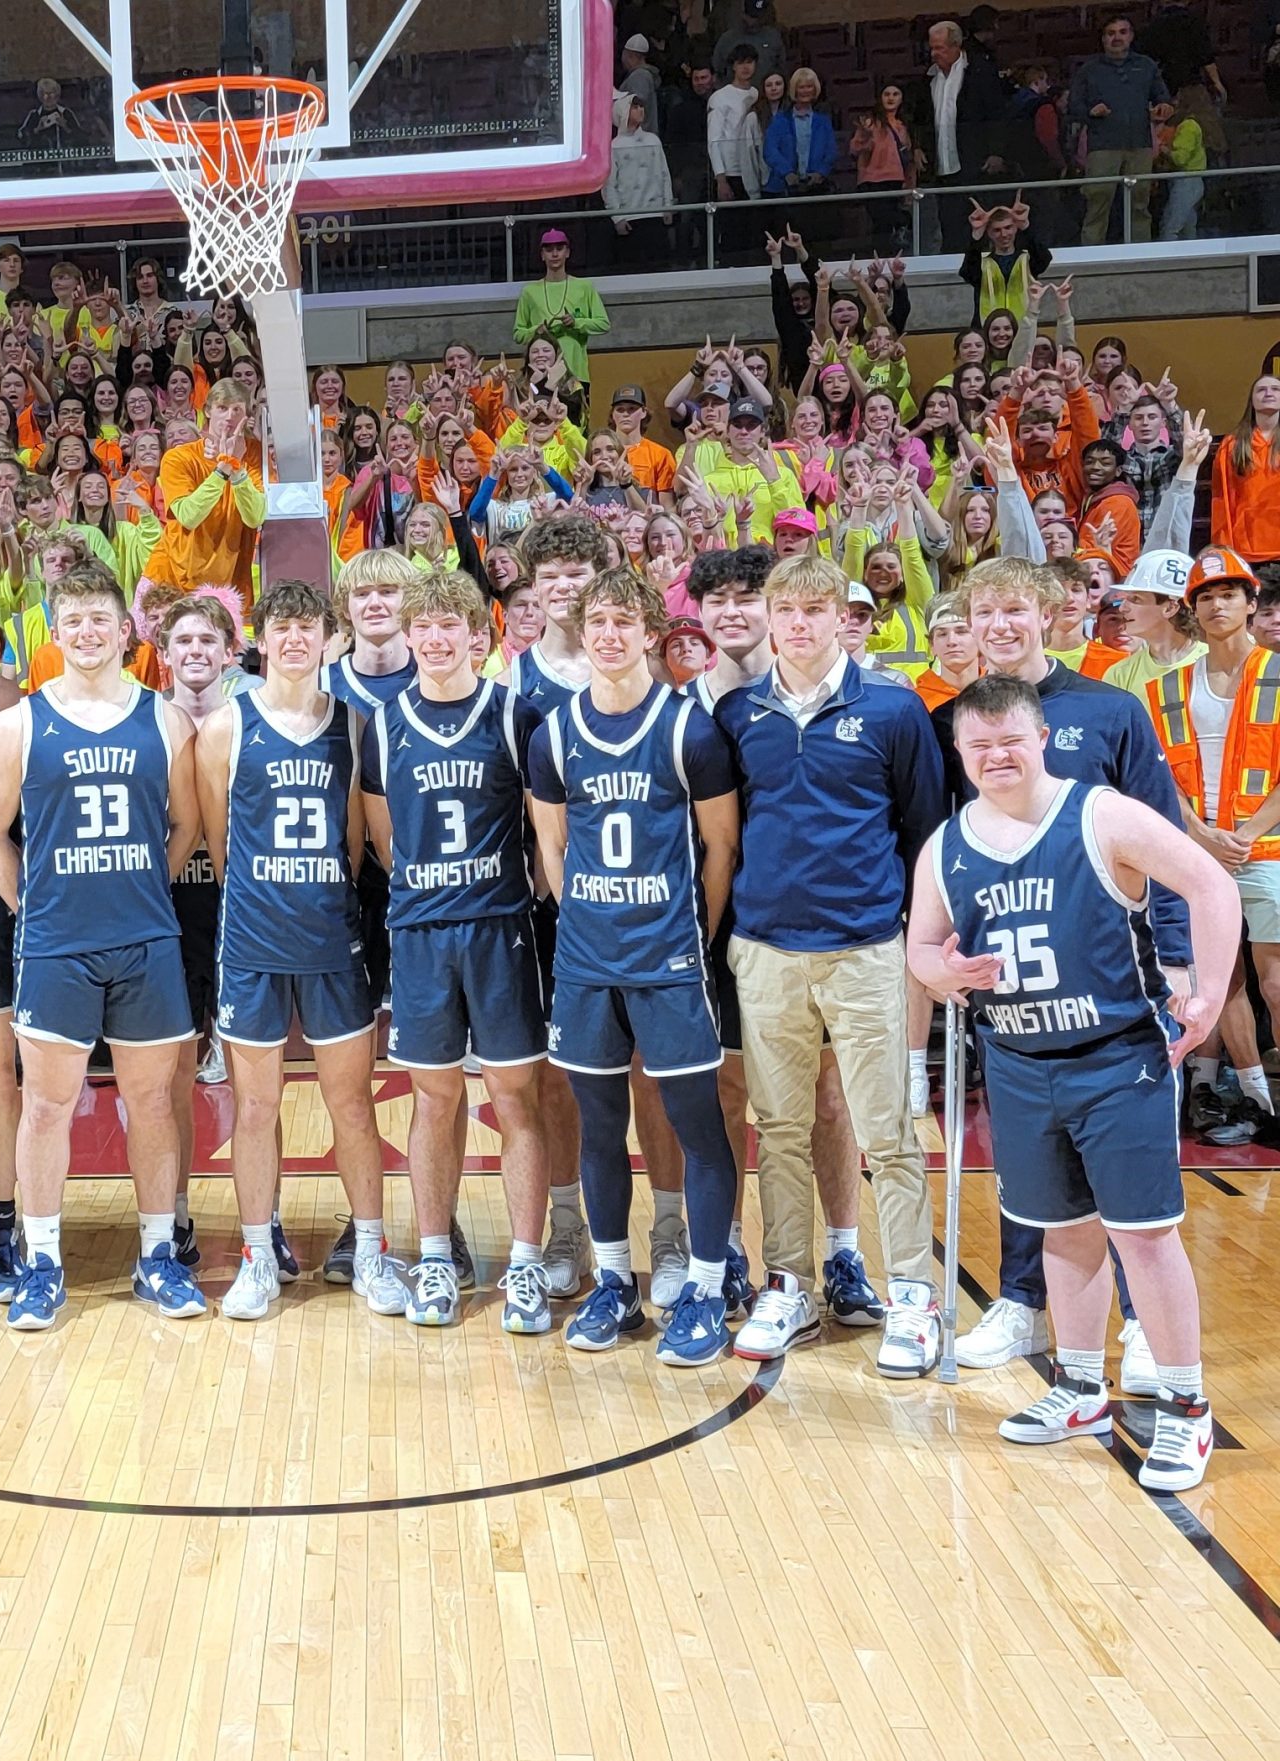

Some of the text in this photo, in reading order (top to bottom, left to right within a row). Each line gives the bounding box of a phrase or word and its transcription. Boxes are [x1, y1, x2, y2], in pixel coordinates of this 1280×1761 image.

[63, 747, 137, 778] SOUTH
[265, 759, 334, 790] SOUTH
[412, 760, 484, 794] SOUTH
[582, 772, 651, 805] SOUTH
[74, 784, 130, 839] 33
[274, 797, 327, 849] 23
[437, 799, 467, 855] 3
[54, 843, 152, 875] CHRISTIAN
[601, 812, 632, 869] 0
[405, 851, 502, 890] CHRISTIAN
[571, 873, 670, 904] CHRISTIAN
[974, 878, 1055, 921] SOUTH
[986, 923, 1060, 995] 35
